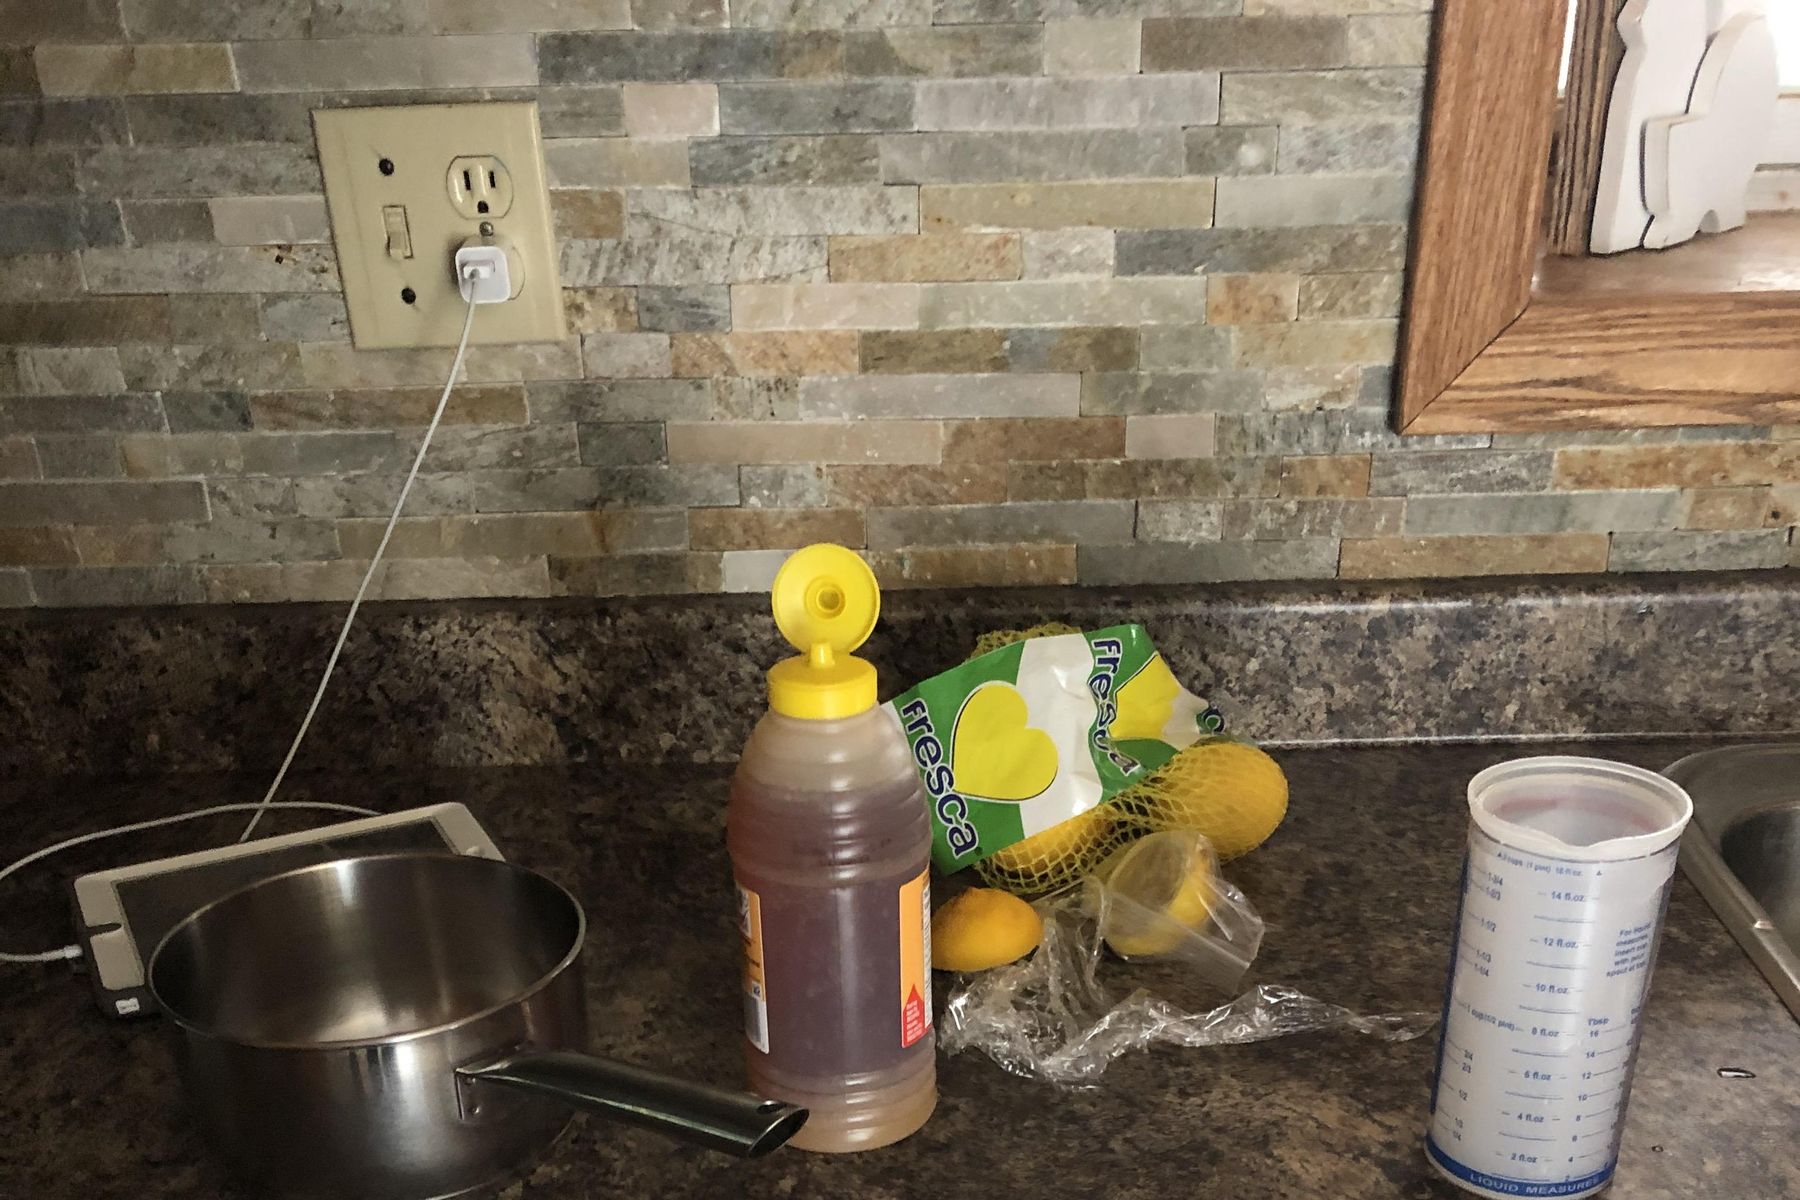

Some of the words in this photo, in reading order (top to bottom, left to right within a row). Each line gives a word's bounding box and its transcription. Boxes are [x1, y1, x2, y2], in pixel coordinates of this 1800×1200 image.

[901, 699, 979, 860] Fresca
[1551, 890, 1562, 900] 14
[1543, 937, 1554, 946] 12
[1535, 982, 1547, 992] 10
[1589, 1030, 1599, 1038] 16
[1586, 1051, 1596, 1059] 14
[1582, 1071, 1592, 1080] 12
[1577, 1093, 1588, 1102] 10
[1469, 1172, 1519, 1193] LIQUID
